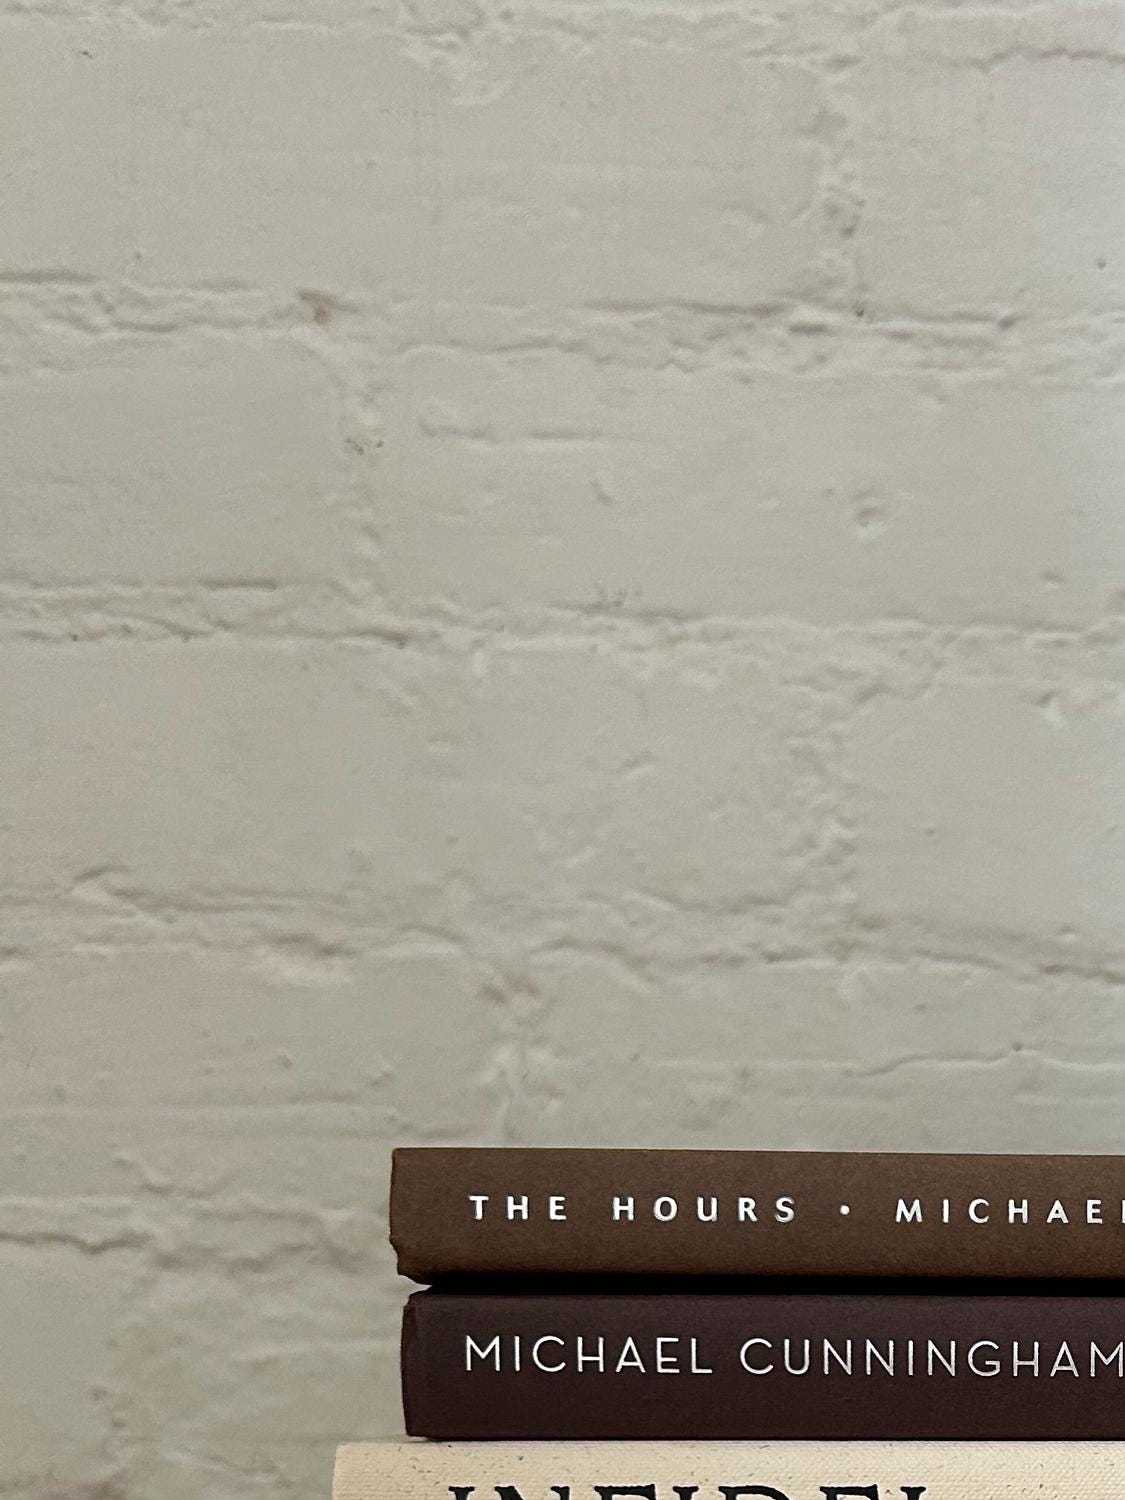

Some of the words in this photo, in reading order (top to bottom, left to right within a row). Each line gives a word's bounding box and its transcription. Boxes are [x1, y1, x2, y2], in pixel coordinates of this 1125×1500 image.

[468, 1195, 567, 1221] THE
[612, 1196, 795, 1223] HOURS
[465, 1335, 713, 1374] MICHAEL
[739, 1337, 1124, 1378] CUNNINGHAM
